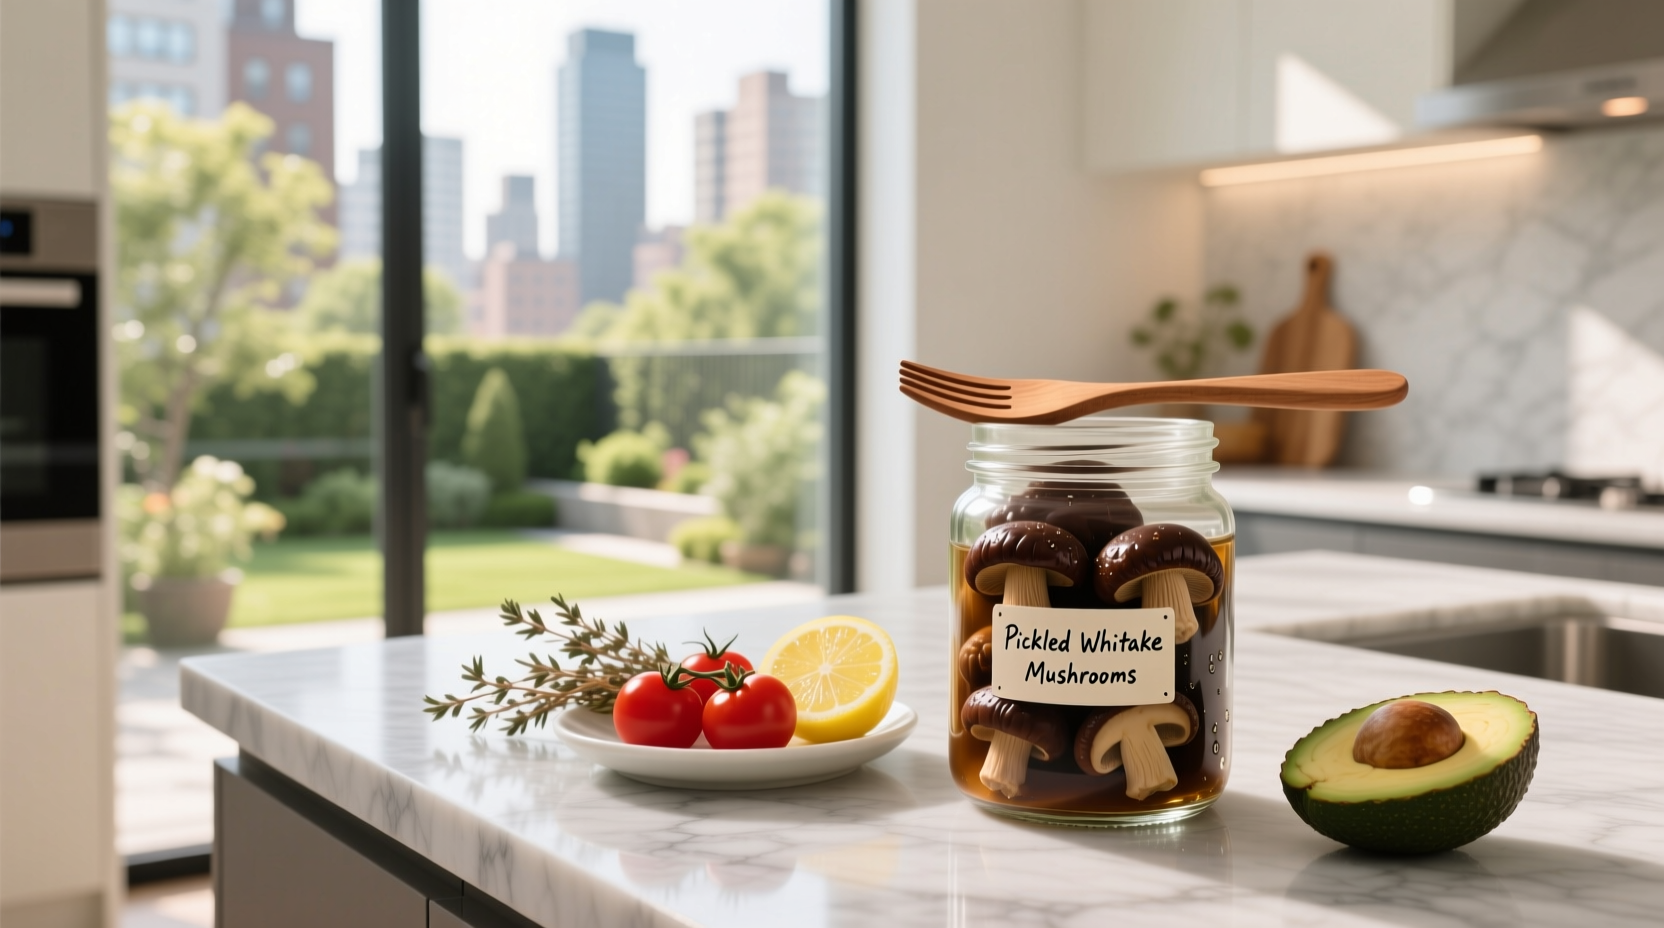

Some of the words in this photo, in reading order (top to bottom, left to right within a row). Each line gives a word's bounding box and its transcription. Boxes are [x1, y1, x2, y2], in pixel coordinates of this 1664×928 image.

[1004, 623, 1071, 653] Pickled
[1080, 628, 1163, 653] Whitake
[1024, 660, 1137, 685] Mushrooms
